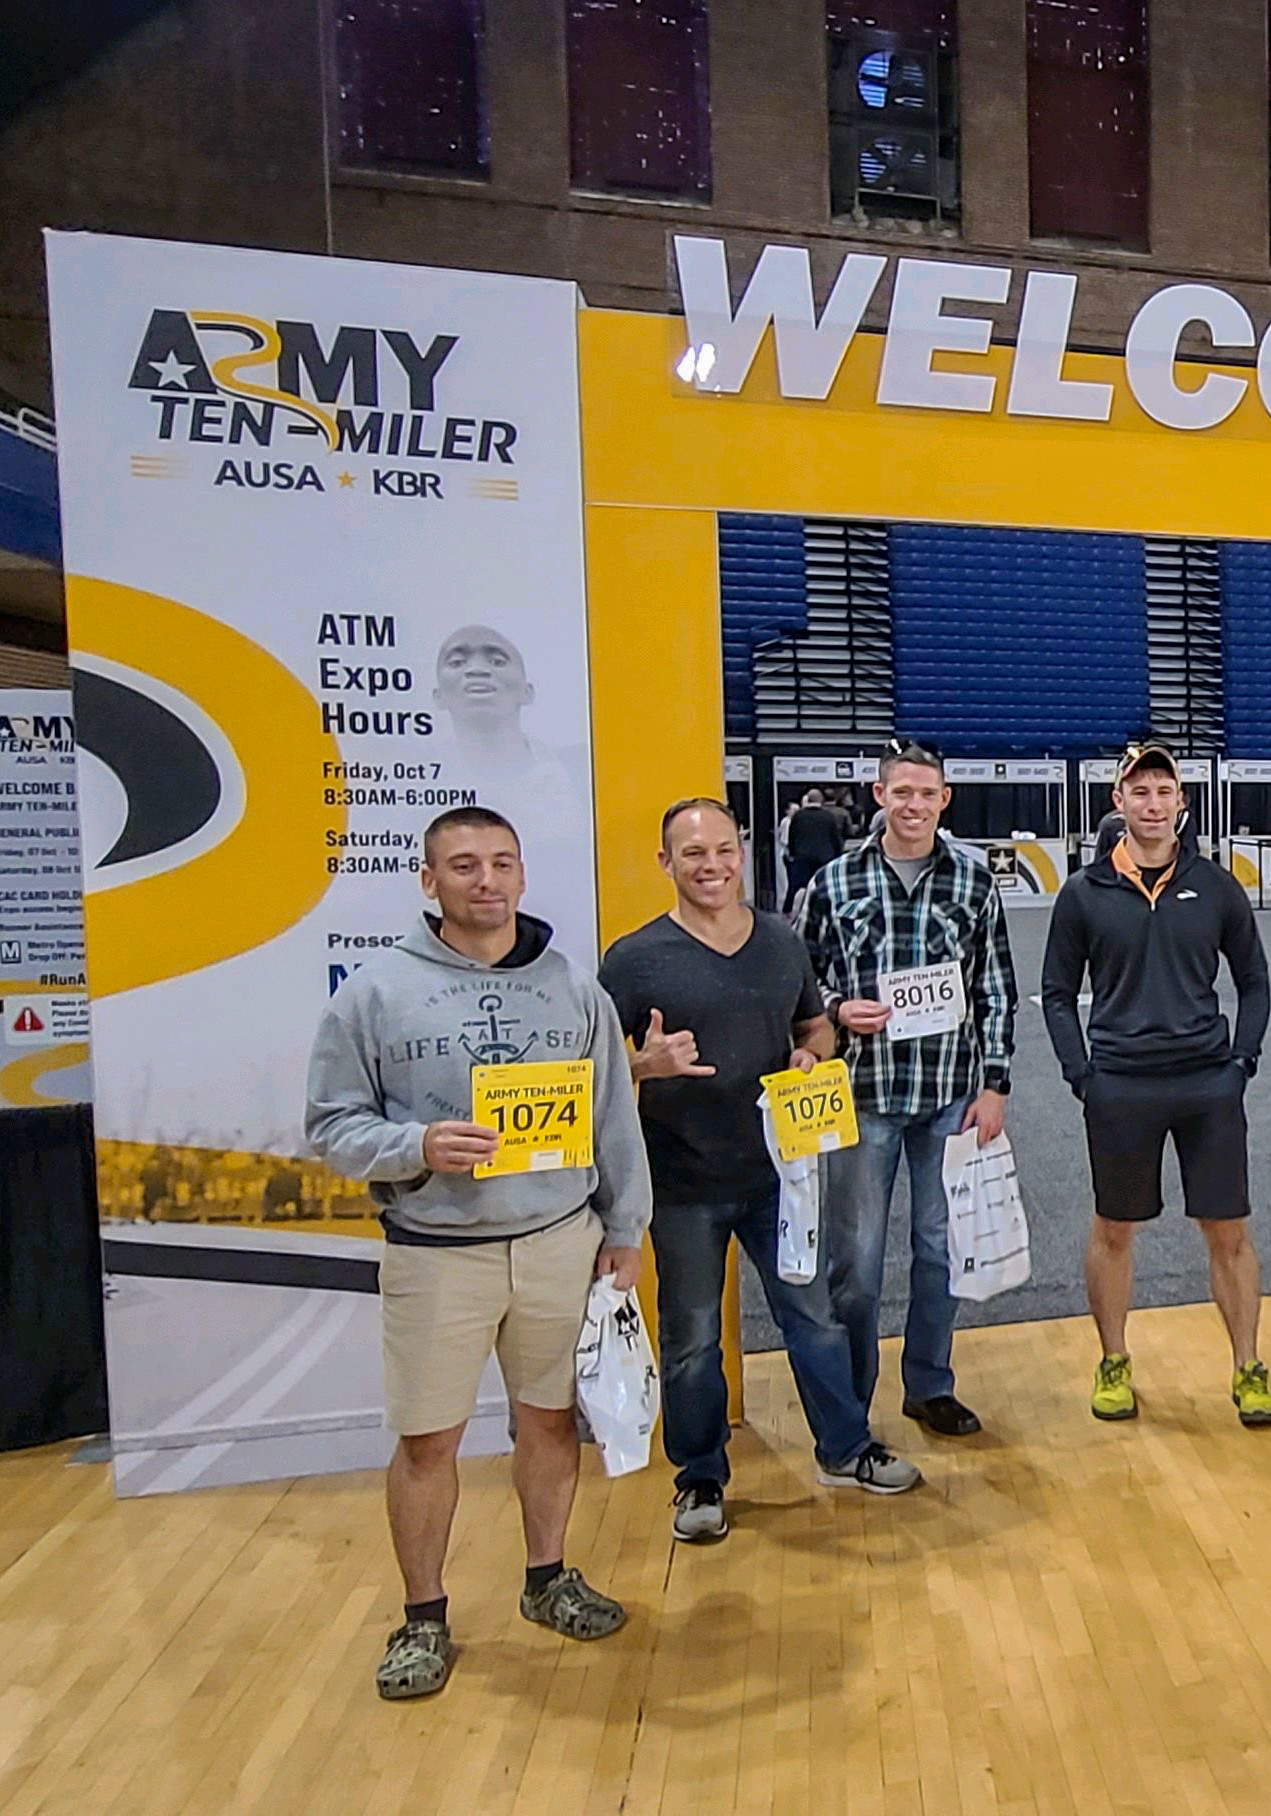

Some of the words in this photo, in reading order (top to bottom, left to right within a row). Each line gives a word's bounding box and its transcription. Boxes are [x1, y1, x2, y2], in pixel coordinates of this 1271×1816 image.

[128, 308, 460, 411] ARMY
[215, 460, 325, 492] AUSA
[373, 469, 444, 499] KBR
[317, 614, 395, 647] ATM
[319, 658, 412, 696] Expo
[321, 702, 433, 735] Hours
[323, 762, 388, 782] Friday,
[394, 763, 426, 779] Oct
[430, 764, 441, 779] 7
[324, 789, 476, 805] 8:30AM-6:00PM
[325, 830, 418, 849] Saturday,
[893, 980, 954, 1008] 8016
[388, 1037, 450, 1064] LIFE
[567, 1065, 586, 1073] 1074
[485, 1088, 521, 1100] ARMY
[784, 1089, 843, 1123] 1076
[490, 1099, 578, 1133] 1074
